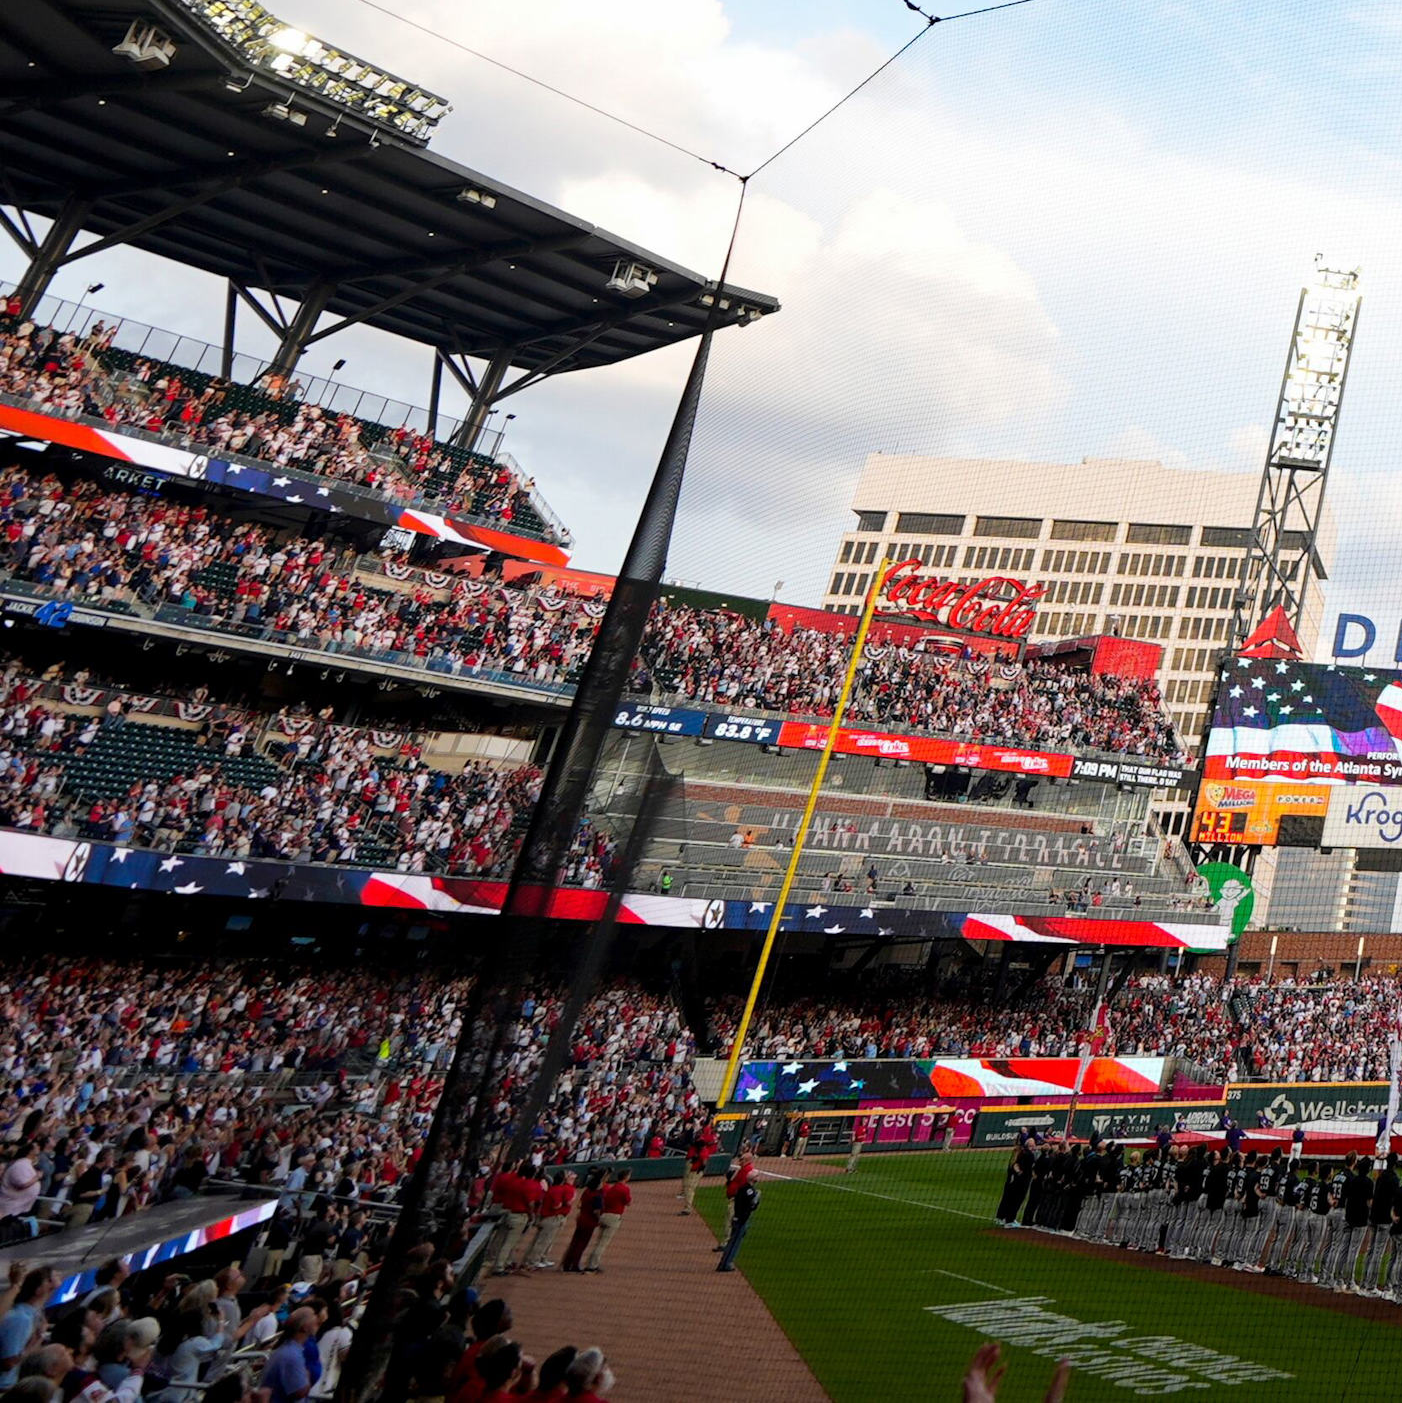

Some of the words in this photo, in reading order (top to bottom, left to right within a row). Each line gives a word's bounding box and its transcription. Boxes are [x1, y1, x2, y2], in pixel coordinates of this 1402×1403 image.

[32, 600, 73, 628] 42
[615, 711, 644, 727] 8.6
[714, 723, 754, 739] 83.8
[1073, 761, 1099, 777] 7:09
[1098, 763, 1118, 778] PM
[1120, 764, 1138, 774] THAT
[1226, 756, 1290, 771] Members
[1294, 758, 1308, 772] of
[1310, 759, 1331, 773] the
[1334, 762, 1381, 776] Atlanta
[1222, 786, 1255, 801] MEGA
[1201, 811, 1233, 833] 43
[1198, 831, 1243, 843] MILLION
[1227, 1090, 1242, 1101] 375
[717, 1120, 736, 1132] 335
[1113, 1114, 1152, 1125] TYM
[1108, 1335, 1298, 1386] CHEROKEE
[1032, 1344, 1213, 1396] CASINOS
